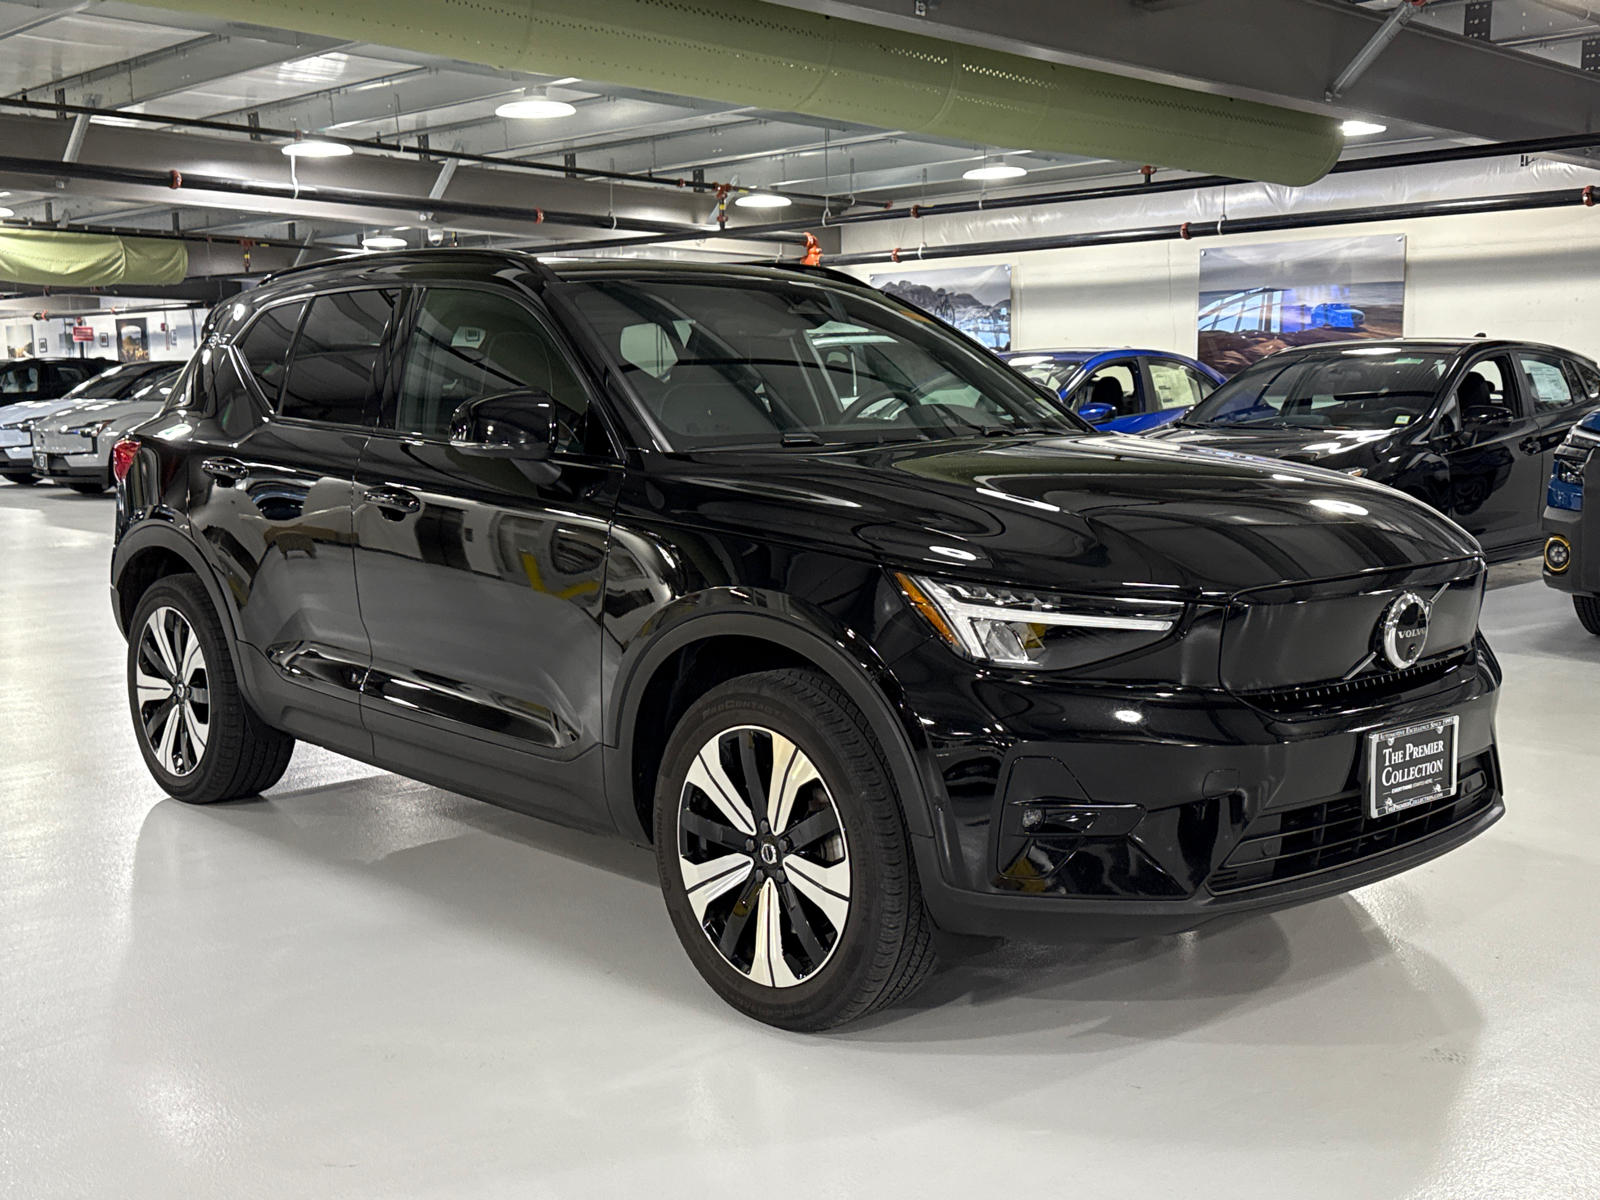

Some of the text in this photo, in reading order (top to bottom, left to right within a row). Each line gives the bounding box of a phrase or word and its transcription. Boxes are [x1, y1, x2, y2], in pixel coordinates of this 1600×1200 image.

[1383, 740, 1444, 766] THE PREMIER
[1382, 759, 1444, 786] COLLECTION
